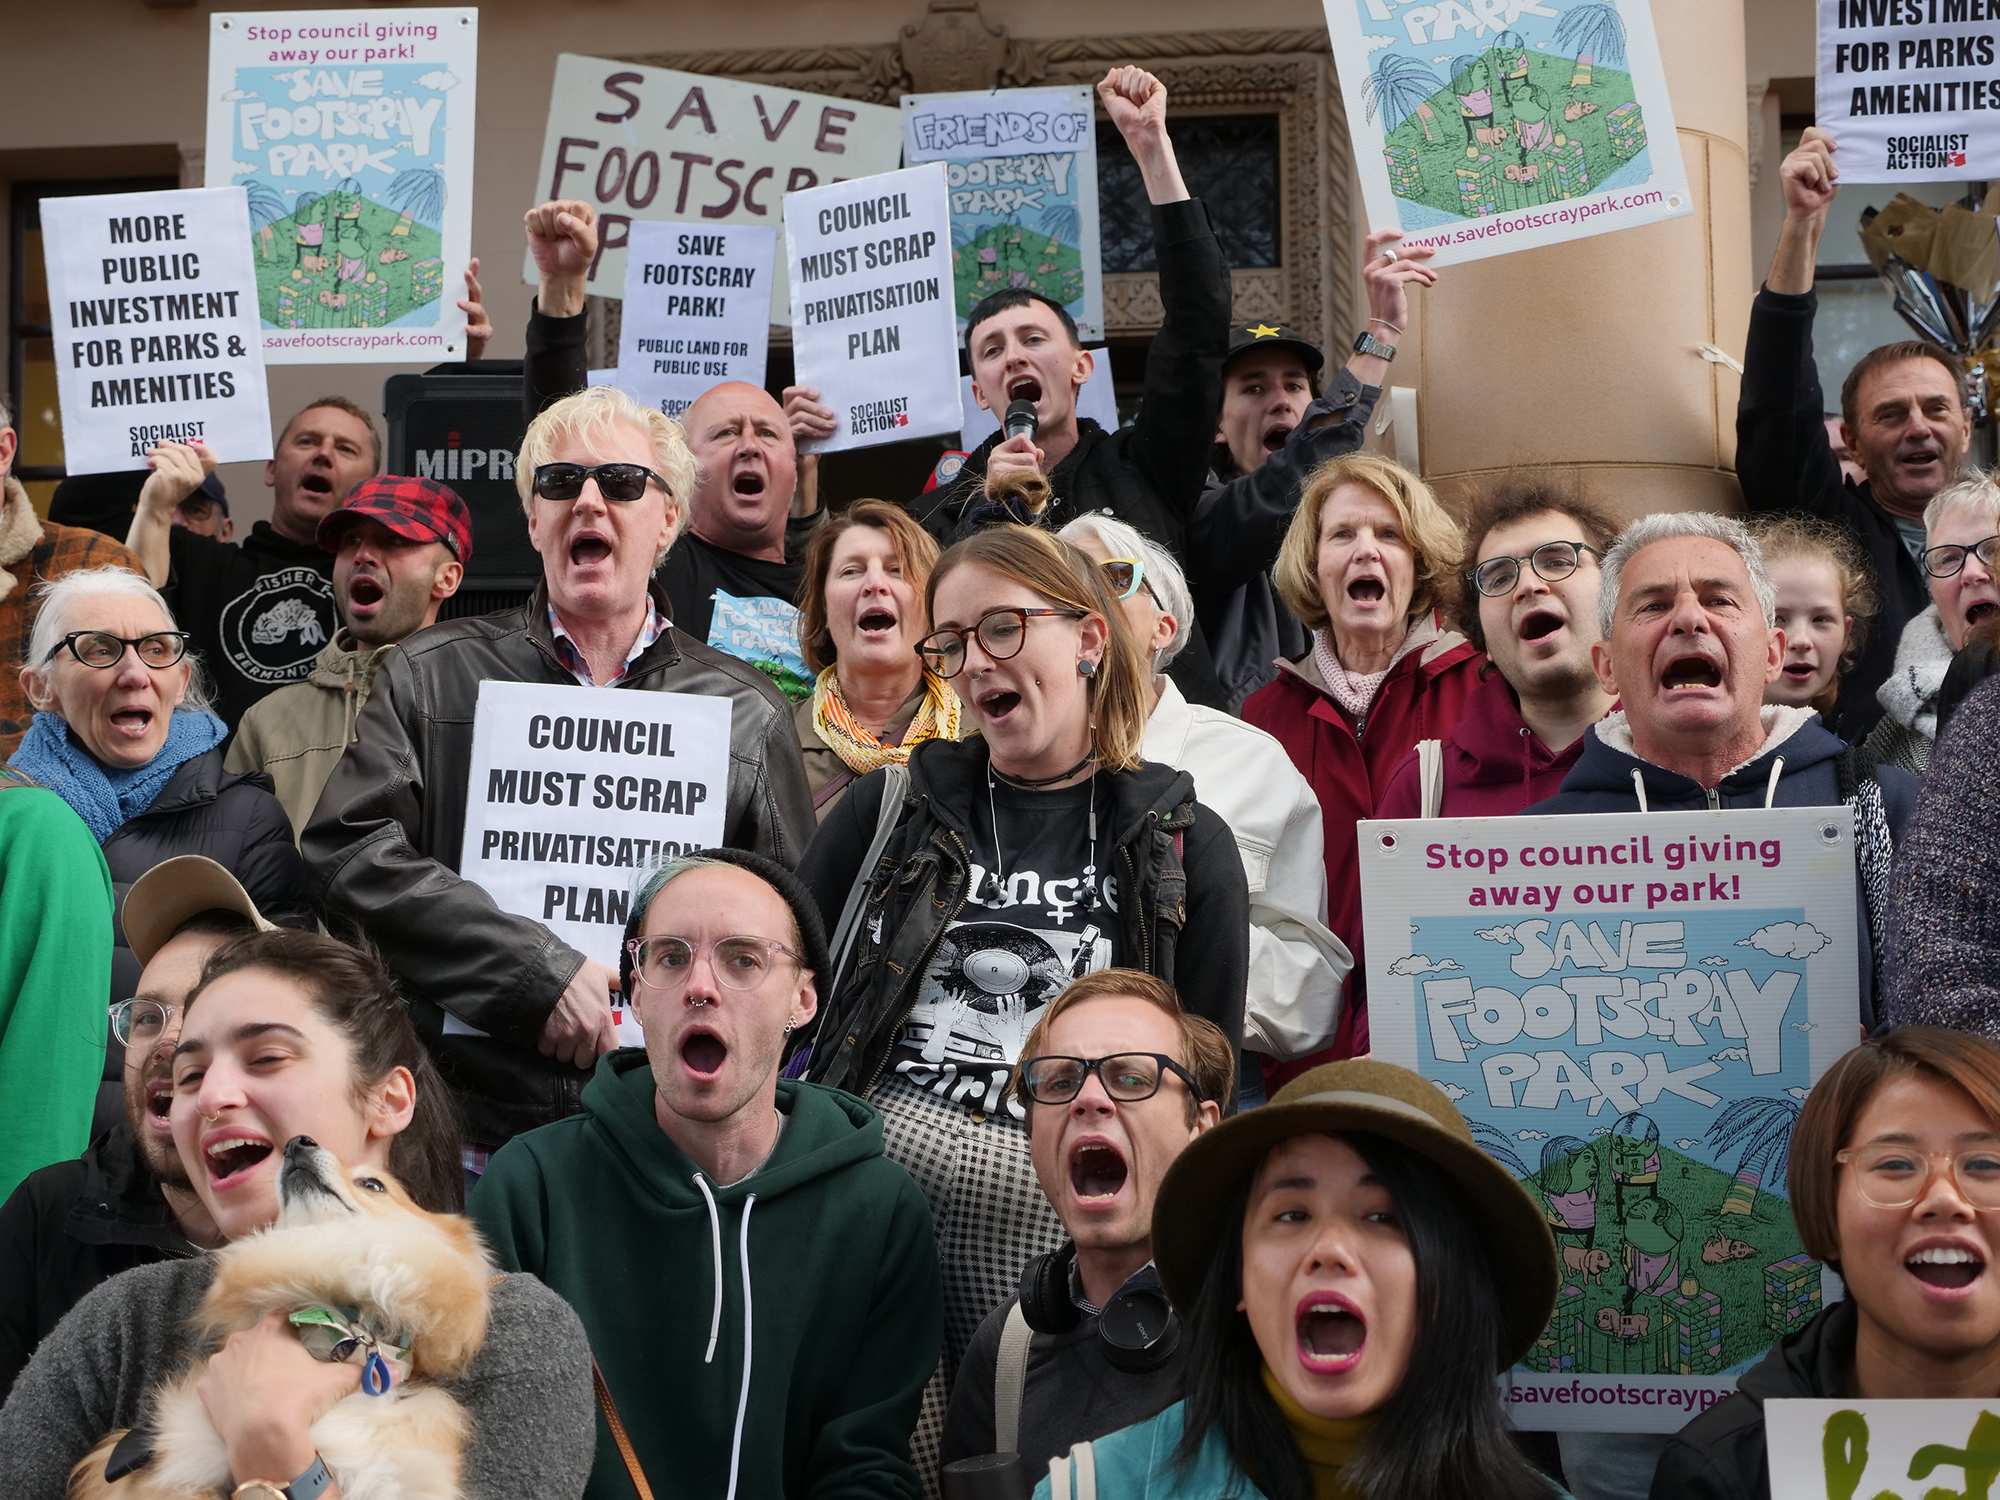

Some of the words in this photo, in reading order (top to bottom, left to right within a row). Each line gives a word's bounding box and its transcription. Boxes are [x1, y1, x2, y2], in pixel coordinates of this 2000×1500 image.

[247, 26, 292, 43] Stop
[298, 22, 370, 39] council
[375, 22, 438, 41] giving
[1838, 0, 2000, 29] INVESTMEN
[268, 49, 319, 64] away
[325, 48, 359, 60] our
[364, 43, 415, 62] park!
[1836, 41, 1890, 73] FOR
[1898, 35, 1995, 70] PARKS
[288, 68, 384, 102] SAVE
[1849, 79, 2000, 117] AMENITIES
[239, 96, 443, 156] FOOTSCRAY
[595, 71, 857, 154] SAVE
[913, 112, 1049, 150] FRIENDS
[1052, 112, 1087, 143] OF
[1886, 134, 1969, 153] SOCIALIST
[267, 143, 397, 180] PARK
[948, 152, 1075, 197] OOTSCRAY
[1886, 151, 1948, 170] ACTION
[818, 192, 911, 236] COUNCIL
[952, 187, 1045, 216] PARK
[109, 214, 187, 244] MORE
[677, 234, 727, 256] SAVE
[102, 252, 200, 285] PUBLIC
[801, 246, 859, 283] MUST
[864, 230, 936, 270] SCRAP
[643, 264, 756, 288] FOOTSCRAY
[70, 290, 240, 328] INVESTMENT
[667, 295, 726, 318] PARK!
[804, 277, 940, 326] PRIVATISATION
[72, 339, 124, 369] FOR
[130, 332, 219, 364] PARKS
[227, 335, 247, 357] &
[262, 332, 443, 349] .savefootscraypark.com
[637, 338, 684, 354] PUBLIC
[687, 340, 720, 355] LAND
[723, 342, 748, 357] FOR
[848, 325, 901, 361] PLAN
[653, 359, 700, 376] PUBLIC
[704, 362, 728, 376] USE
[91, 371, 236, 408] AMENITIES
[850, 396, 909, 421] SOCIALIST
[851, 413, 897, 436] ACTION
[129, 421, 205, 442] SOCIALIST
[255, 571, 316, 592] FISHER
[234, 653, 317, 680] BERMONDS
[528, 714, 676, 757] COUNCIL
[487, 768, 586, 807] MUST
[592, 774, 708, 816] SCRAP
[1425, 843, 1509, 874] Stop
[1519, 836, 1654, 866] council
[1663, 833, 1781, 870] giving
[542, 884, 630, 926] PLAN
[1468, 884, 1563, 912] away
[1573, 881, 1634, 904] our
[1646, 873, 1741, 910] park!
[1510, 918, 1688, 979] SAVE
[1422, 968, 1801, 1077] FOOTSCRAY
[1480, 1049, 1724, 1117] PARK
